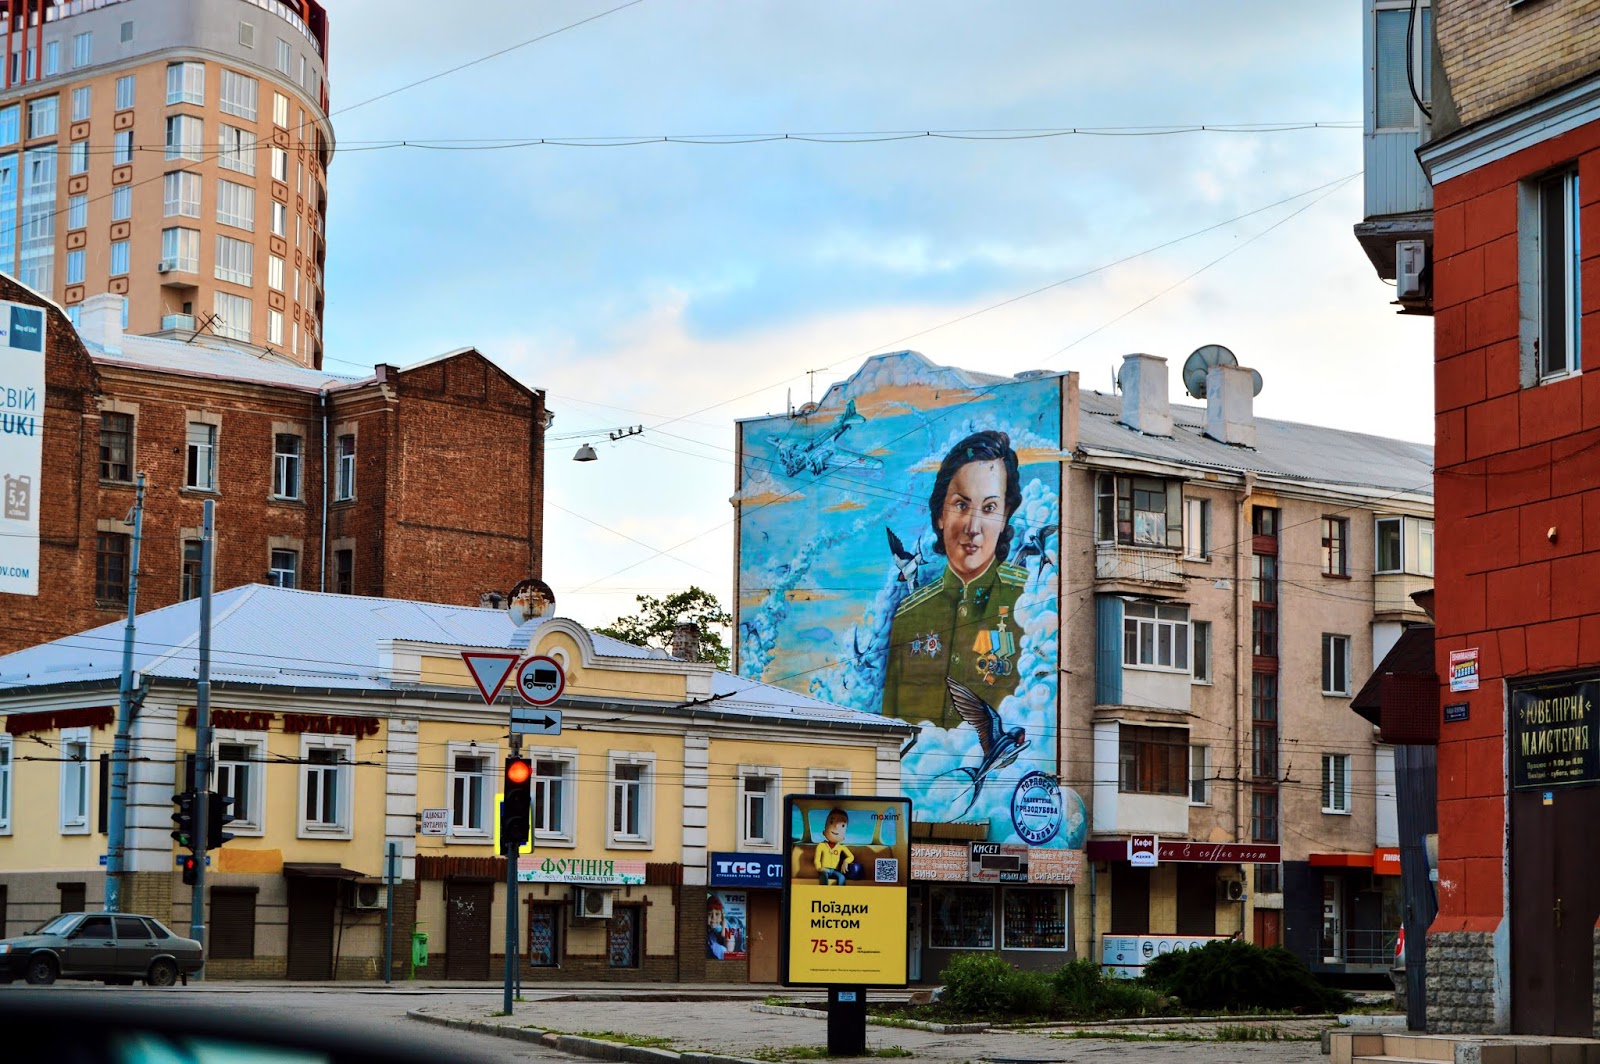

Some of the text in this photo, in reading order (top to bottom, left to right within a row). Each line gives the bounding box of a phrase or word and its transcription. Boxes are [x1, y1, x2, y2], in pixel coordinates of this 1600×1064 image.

[0, 412, 34, 437] UKI
[8, 489, 26, 508] 5,2
[1526, 695, 1584, 725] ЮВЕЛІРНА
[1021, 777, 1054, 795] ГОРДОСТЬ
[1016, 804, 1058, 814] ГРИЗОДУБОВА
[1018, 820, 1054, 840] ХАРЬКОВА
[973, 844, 1000, 854] КИСЕТ
[1200, 844, 1232, 861] coffee
[540, 858, 614, 876] ФОТІНІЯ
[914, 870, 937, 878] ВИНО
[811, 900, 868, 916] Поїздки
[810, 916, 860, 929] містом
